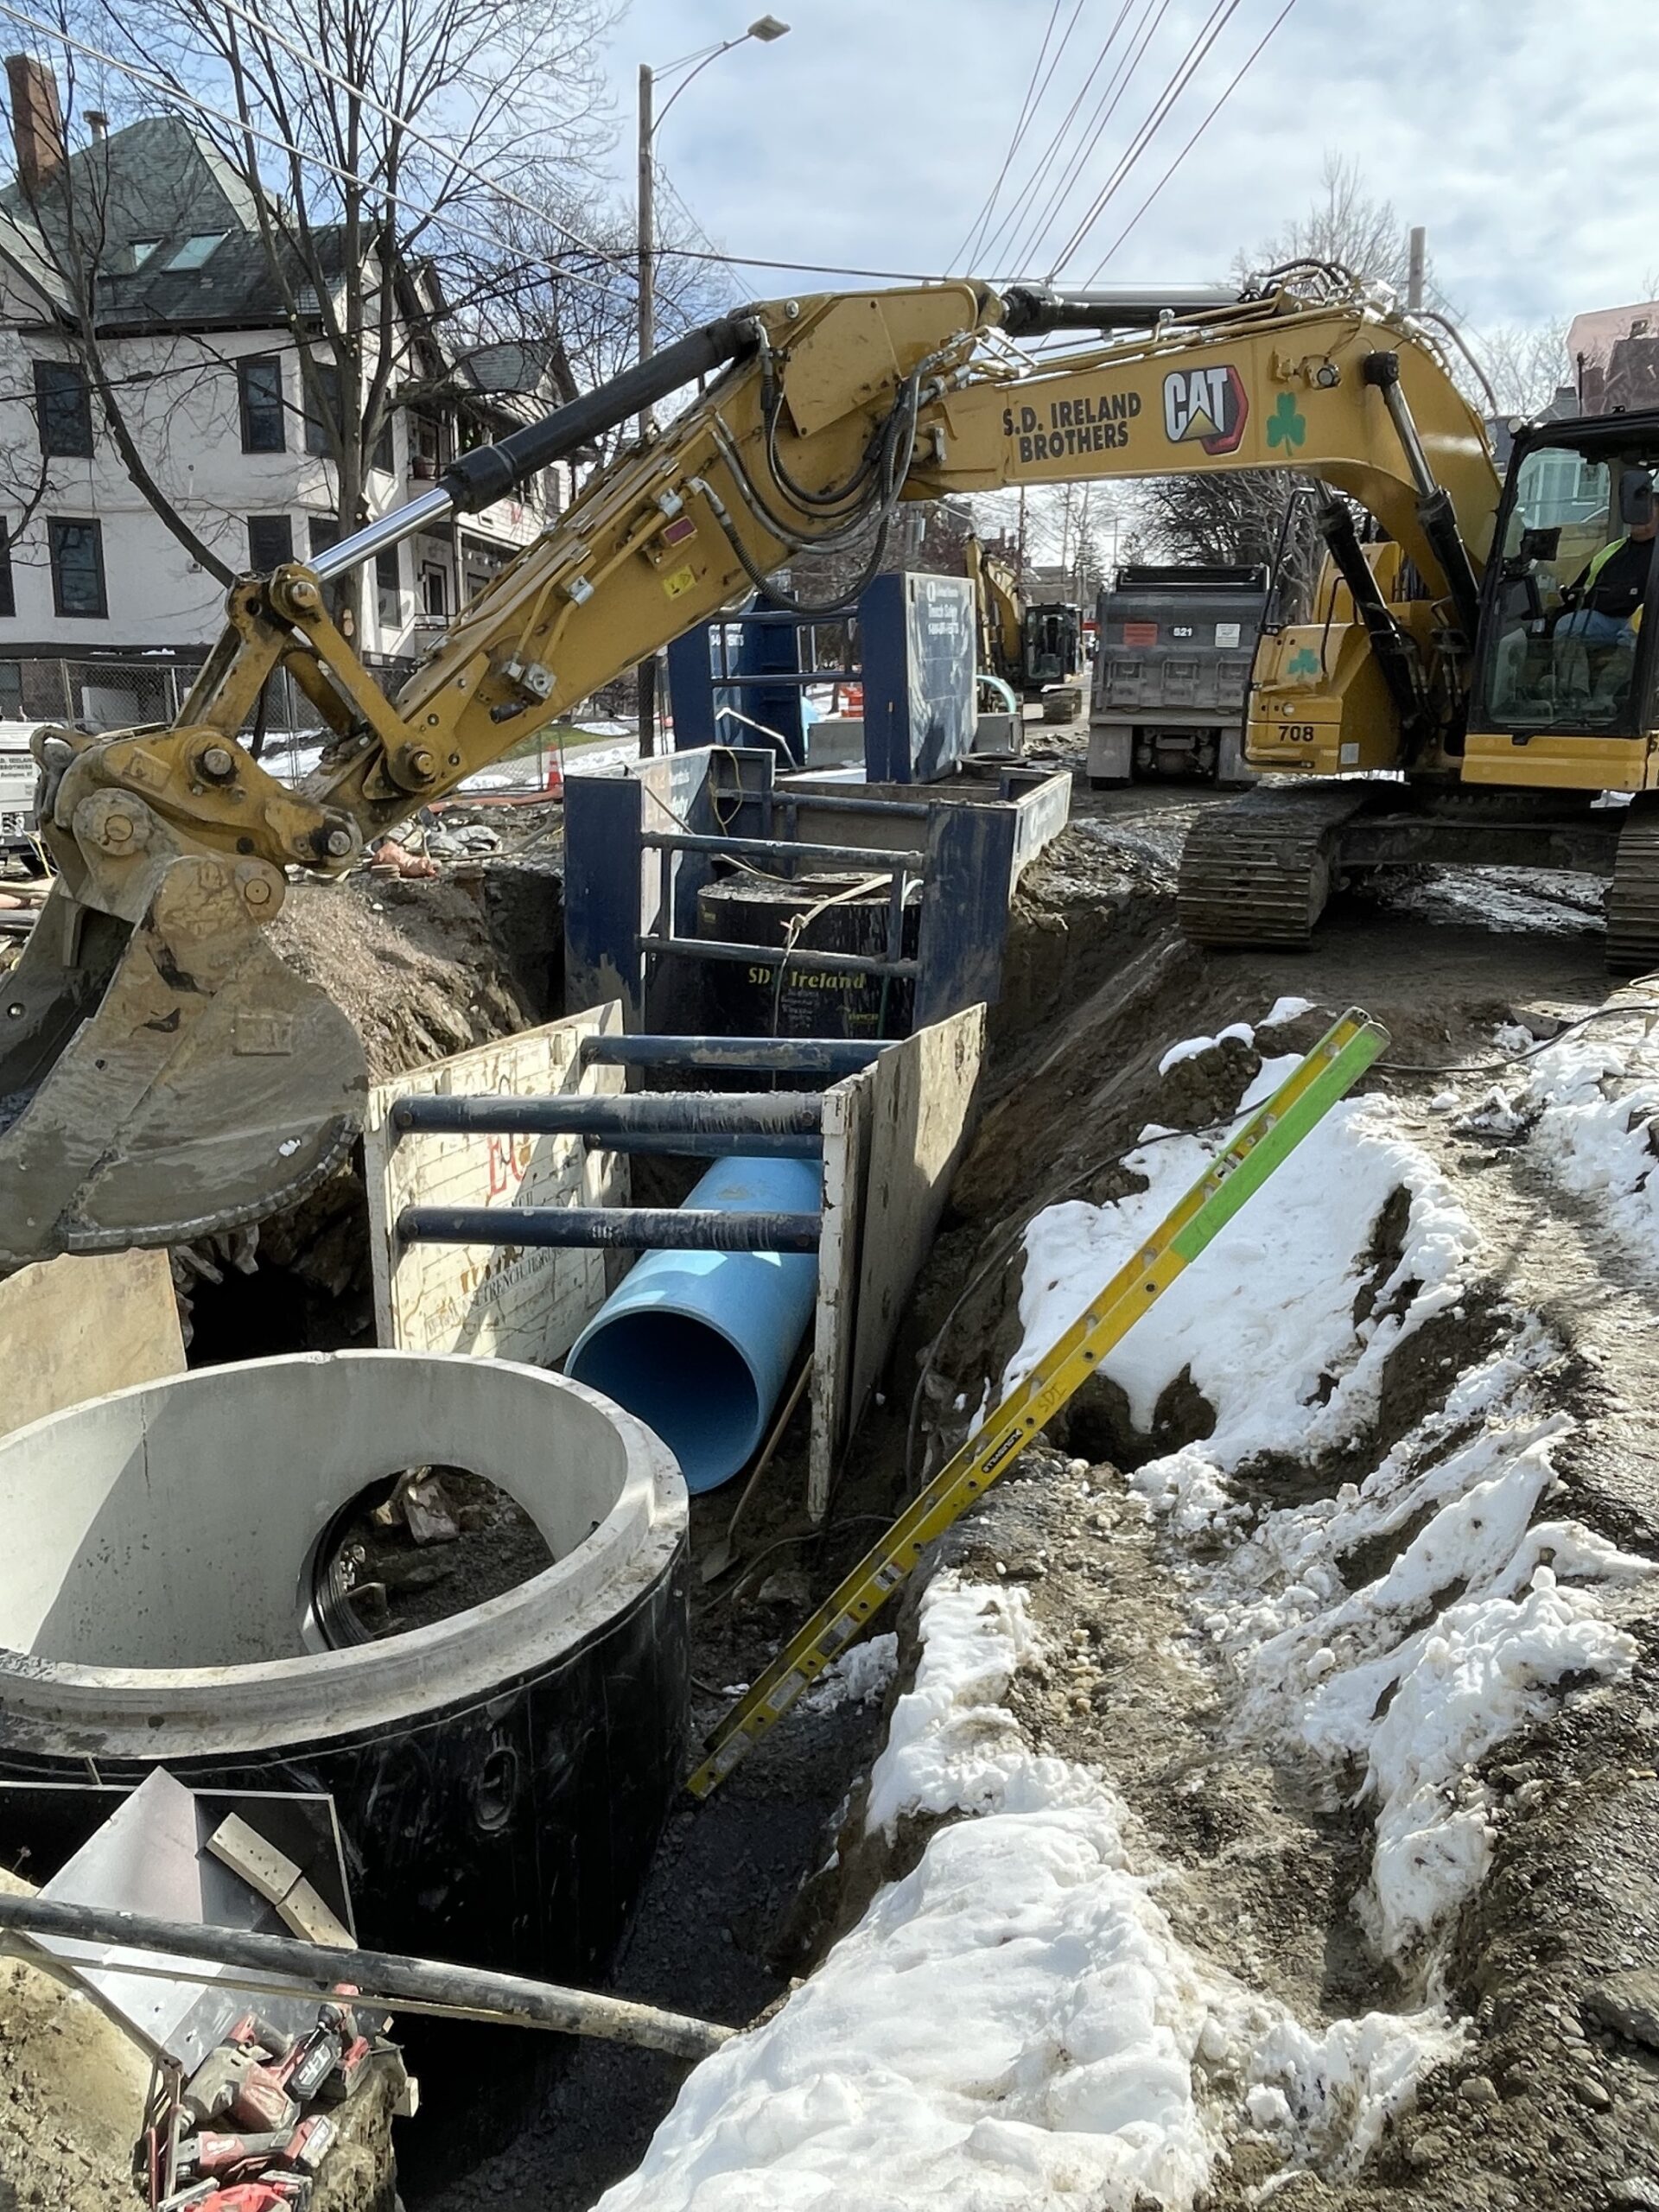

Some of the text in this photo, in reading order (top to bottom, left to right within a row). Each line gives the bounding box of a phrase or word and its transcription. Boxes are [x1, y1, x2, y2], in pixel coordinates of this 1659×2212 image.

[1002, 392, 1141, 436] S.D. IRELAND
[1164, 368, 1228, 442] CAT
[1019, 422, 1128, 463] BROTHERS
[1278, 725, 1314, 742] 708
[748, 967, 865, 989] SD Ireland
